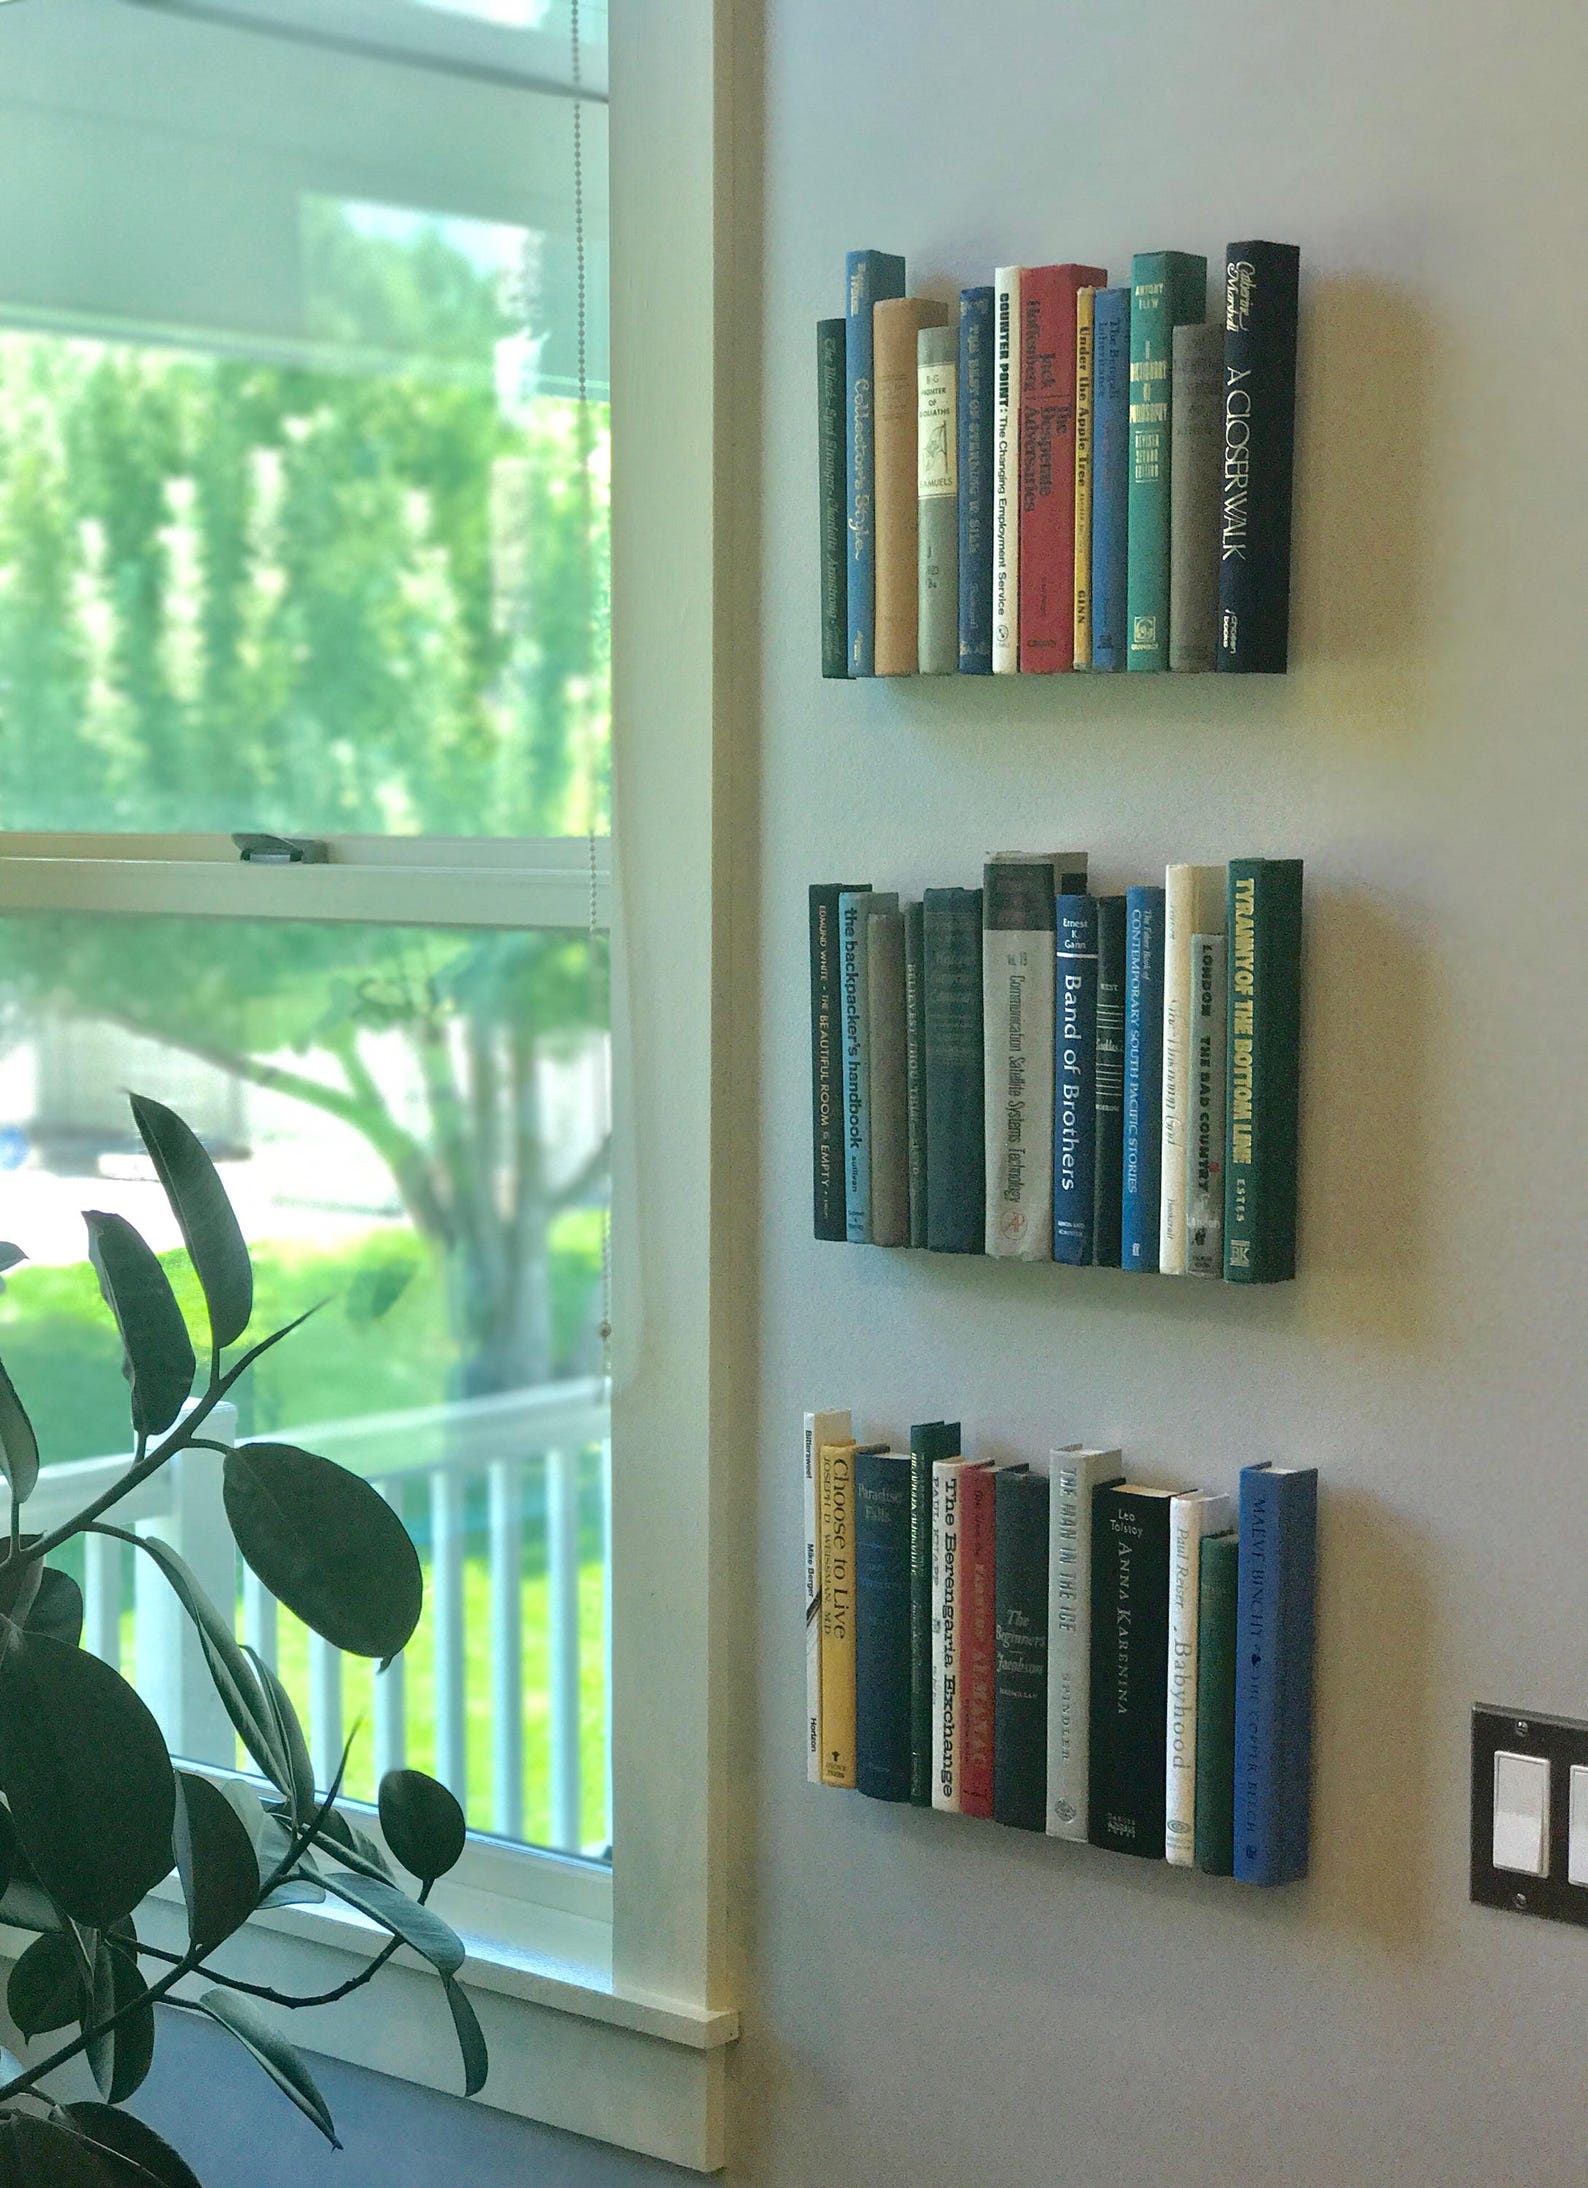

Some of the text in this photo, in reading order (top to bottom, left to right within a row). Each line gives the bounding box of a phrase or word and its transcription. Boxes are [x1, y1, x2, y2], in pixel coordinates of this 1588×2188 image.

[1078, 326, 1090, 371] Under
[1078, 376, 1089, 401] the
[997, 293, 1010, 616] COUNTER POINT: The Changing Employment Service
[1076, 407, 1089, 447] Apple
[1224, 390, 1251, 492] CLOSER
[1078, 457, 1089, 487] Tree
[1222, 490, 1249, 561] WALK
[1077, 590, 1086, 625] GINN
[818, 904, 828, 948] EDMUND
[1064, 939, 1087, 949] Gann
[820, 951, 829, 980] WHITE
[844, 907, 863, 1149] the backpacker's handbook
[1008, 975, 1026, 1052] Communication
[1233, 878, 1255, 1165] TYRANNY OF THE BOTTOM LINE
[819, 1015, 830, 1080] BEAUTIFUL
[1127, 909, 1142, 1194] CONTEMPORARY SOUTH PACIFIC STORIES
[1198, 944, 1214, 1193] LONDON THE BAD COUNTRY
[1007, 1055, 1027, 1097] Satellite
[1061, 974, 1082, 1191] Band of Brothers
[820, 1083, 830, 1126] ROOM
[1005, 1100, 1026, 1143] Systems
[820, 1144, 830, 1187] EMPTY
[1003, 1147, 1026, 1203] Technology
[1236, 1177, 1246, 1222] ESTES
[805, 1429, 813, 1480] Bittersweet
[823, 1456, 832, 1508] JOSEPH
[1109, 1519, 1144, 1539] Tolstoy
[1118, 1508, 1136, 1522] Leo
[807, 1543, 815, 1599] Mike Berger
[832, 1457, 850, 1640] Choose to Live
[1058, 1467, 1078, 1632] THE MAN IN THE ICE
[1175, 1526, 1190, 1608] Paul Reiser
[1250, 1497, 1267, 1637] MAEVE BINCHY
[941, 1477, 958, 1793] The Berengaria Exchange
[1116, 1541, 1133, 1715] ANNA KARENINA
[1170, 1640, 1193, 1770] Babyhood
[809, 1717, 818, 1753] Horizon
